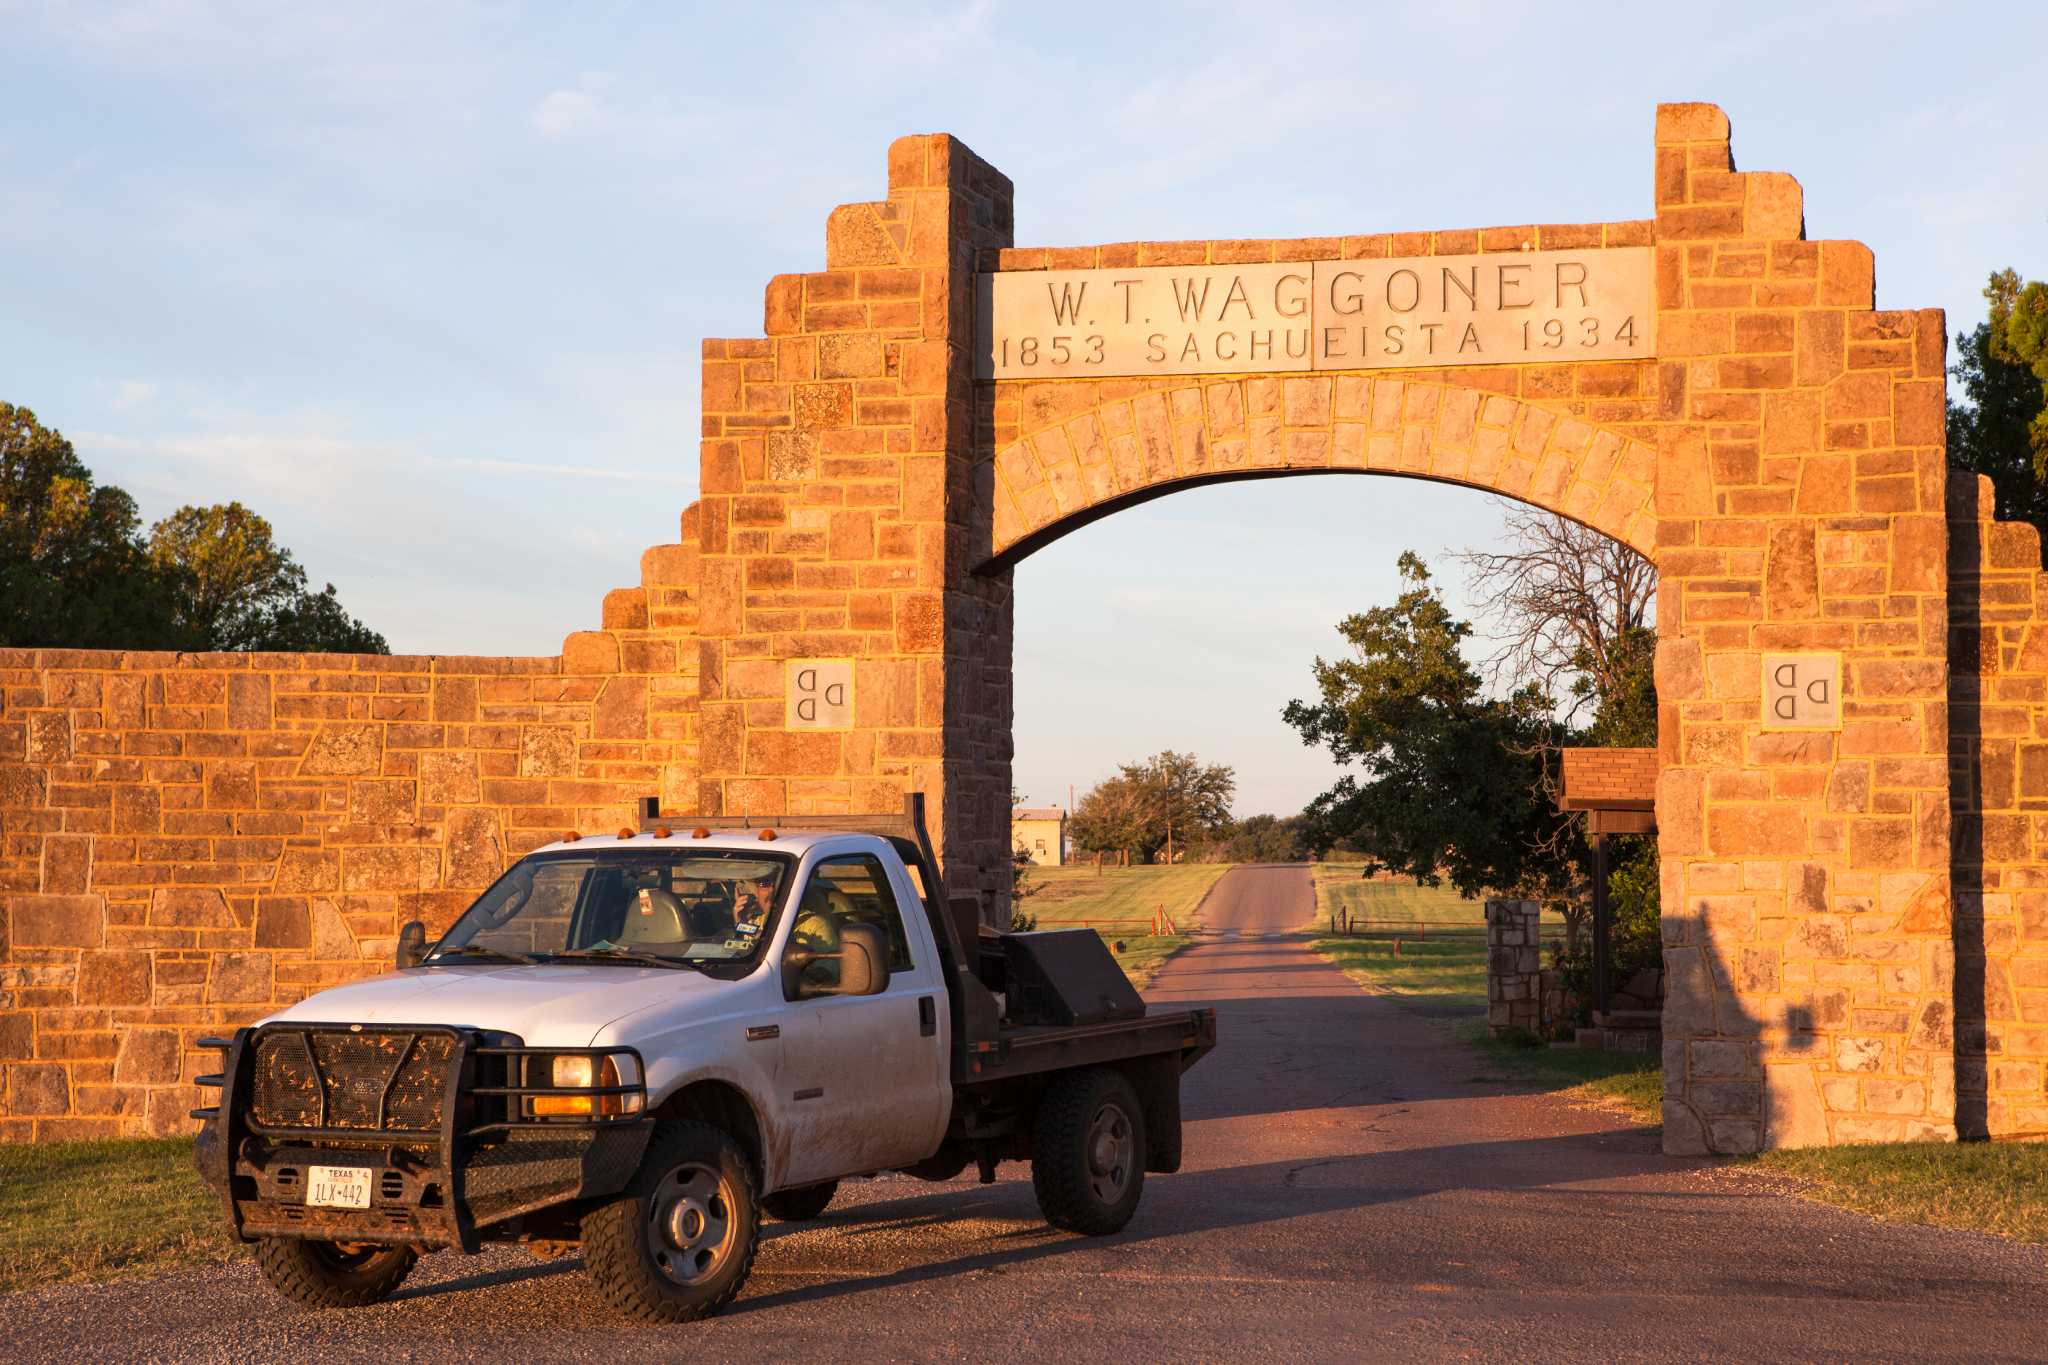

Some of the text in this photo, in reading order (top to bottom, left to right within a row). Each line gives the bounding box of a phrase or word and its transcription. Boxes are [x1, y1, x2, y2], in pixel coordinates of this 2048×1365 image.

[1171, 262, 1589, 322] WAGGONER
[1001, 315, 1639, 368] 1853 SACHUEISTA 1934
[329, 1169, 353, 1178] TEXAS
